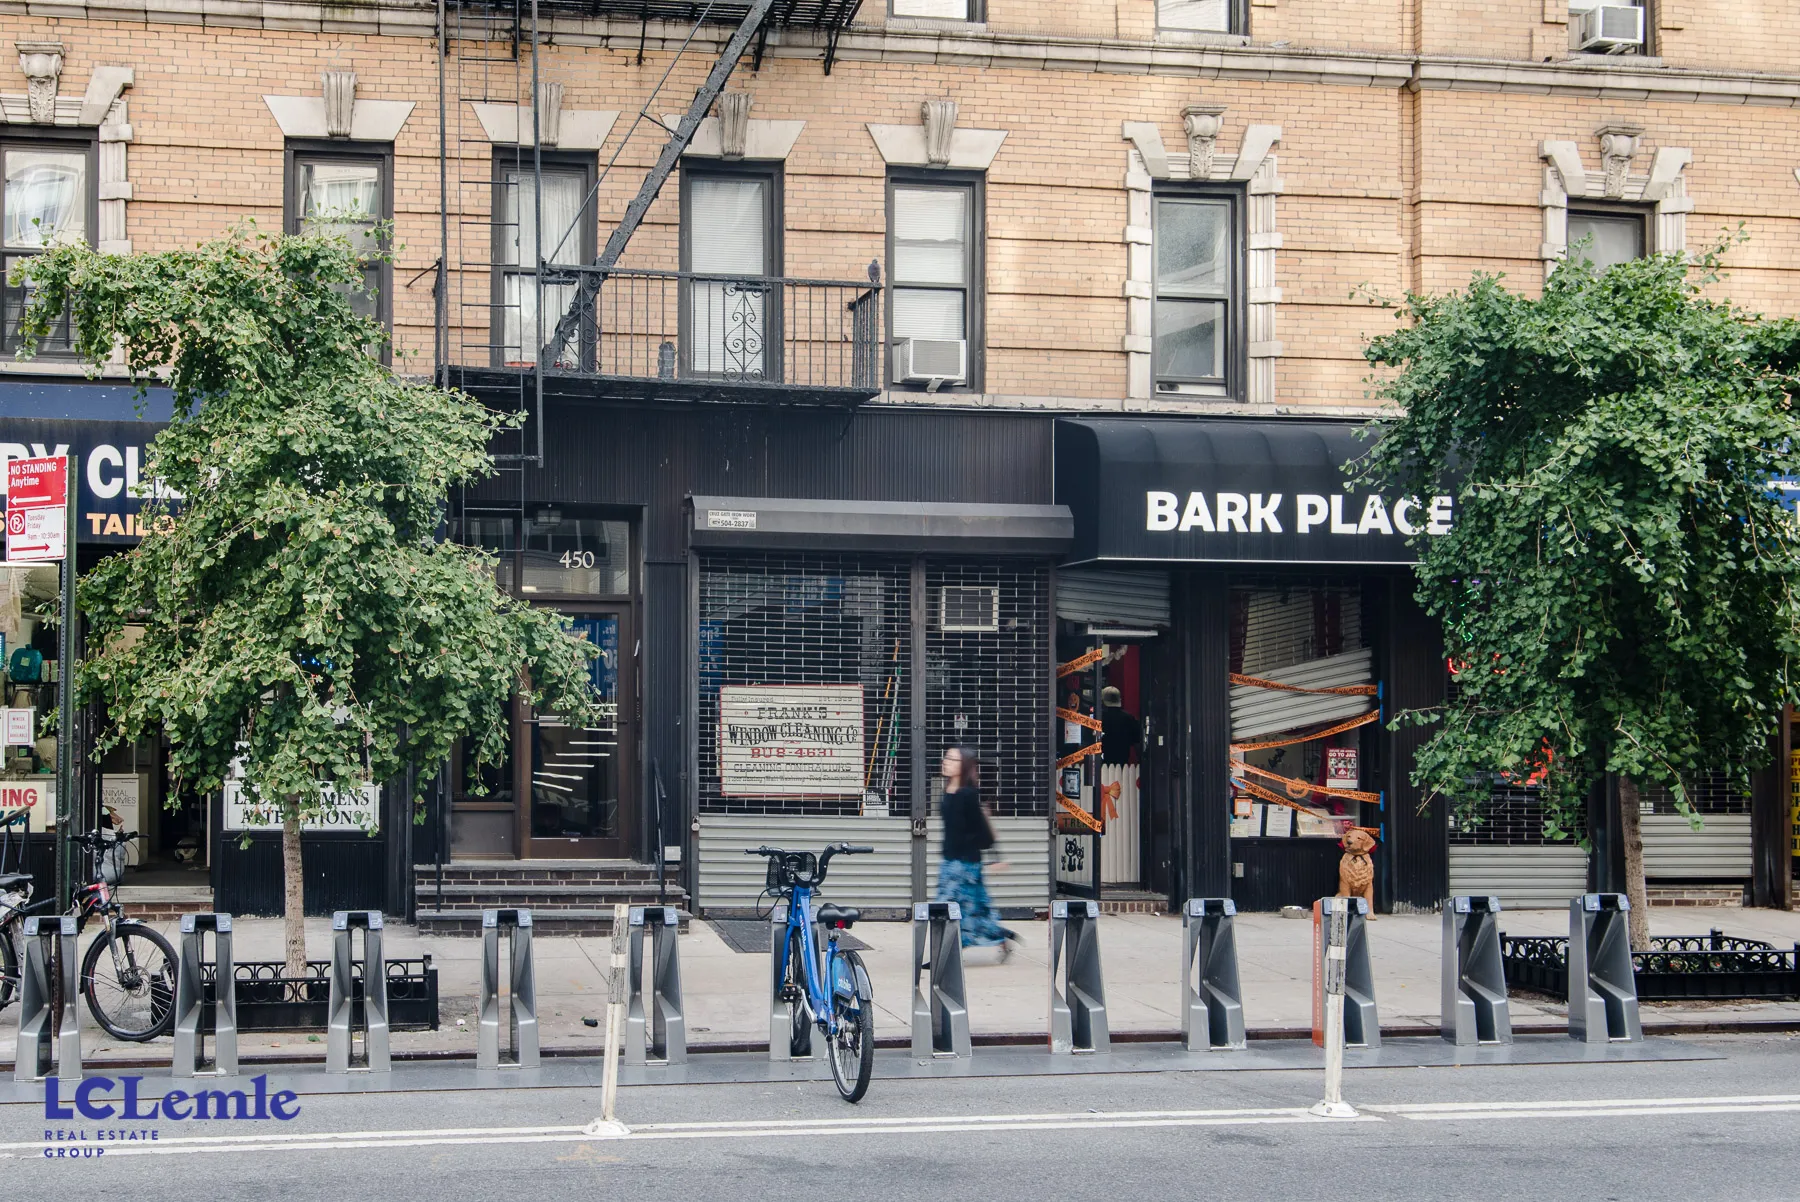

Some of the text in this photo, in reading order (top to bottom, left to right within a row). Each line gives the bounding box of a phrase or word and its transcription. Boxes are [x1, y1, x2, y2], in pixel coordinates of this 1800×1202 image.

[10, 462, 57, 475] NO STANDING
[11, 477, 40, 488] Anytime
[27, 514, 45, 522] Tuesday
[1146, 491, 1454, 535] BARK PLACE
[27, 522, 41, 530] Friday
[720, 520, 749, 528] 504-2837
[559, 549, 595, 569] 450
[757, 706, 828, 720] FRANK'S
[728, 724, 778, 746] WINDOW
[780, 722, 843, 745] CLEANING
[733, 764, 782, 773] CLEANING
[1259, 789, 1284, 804] HAUNTED
